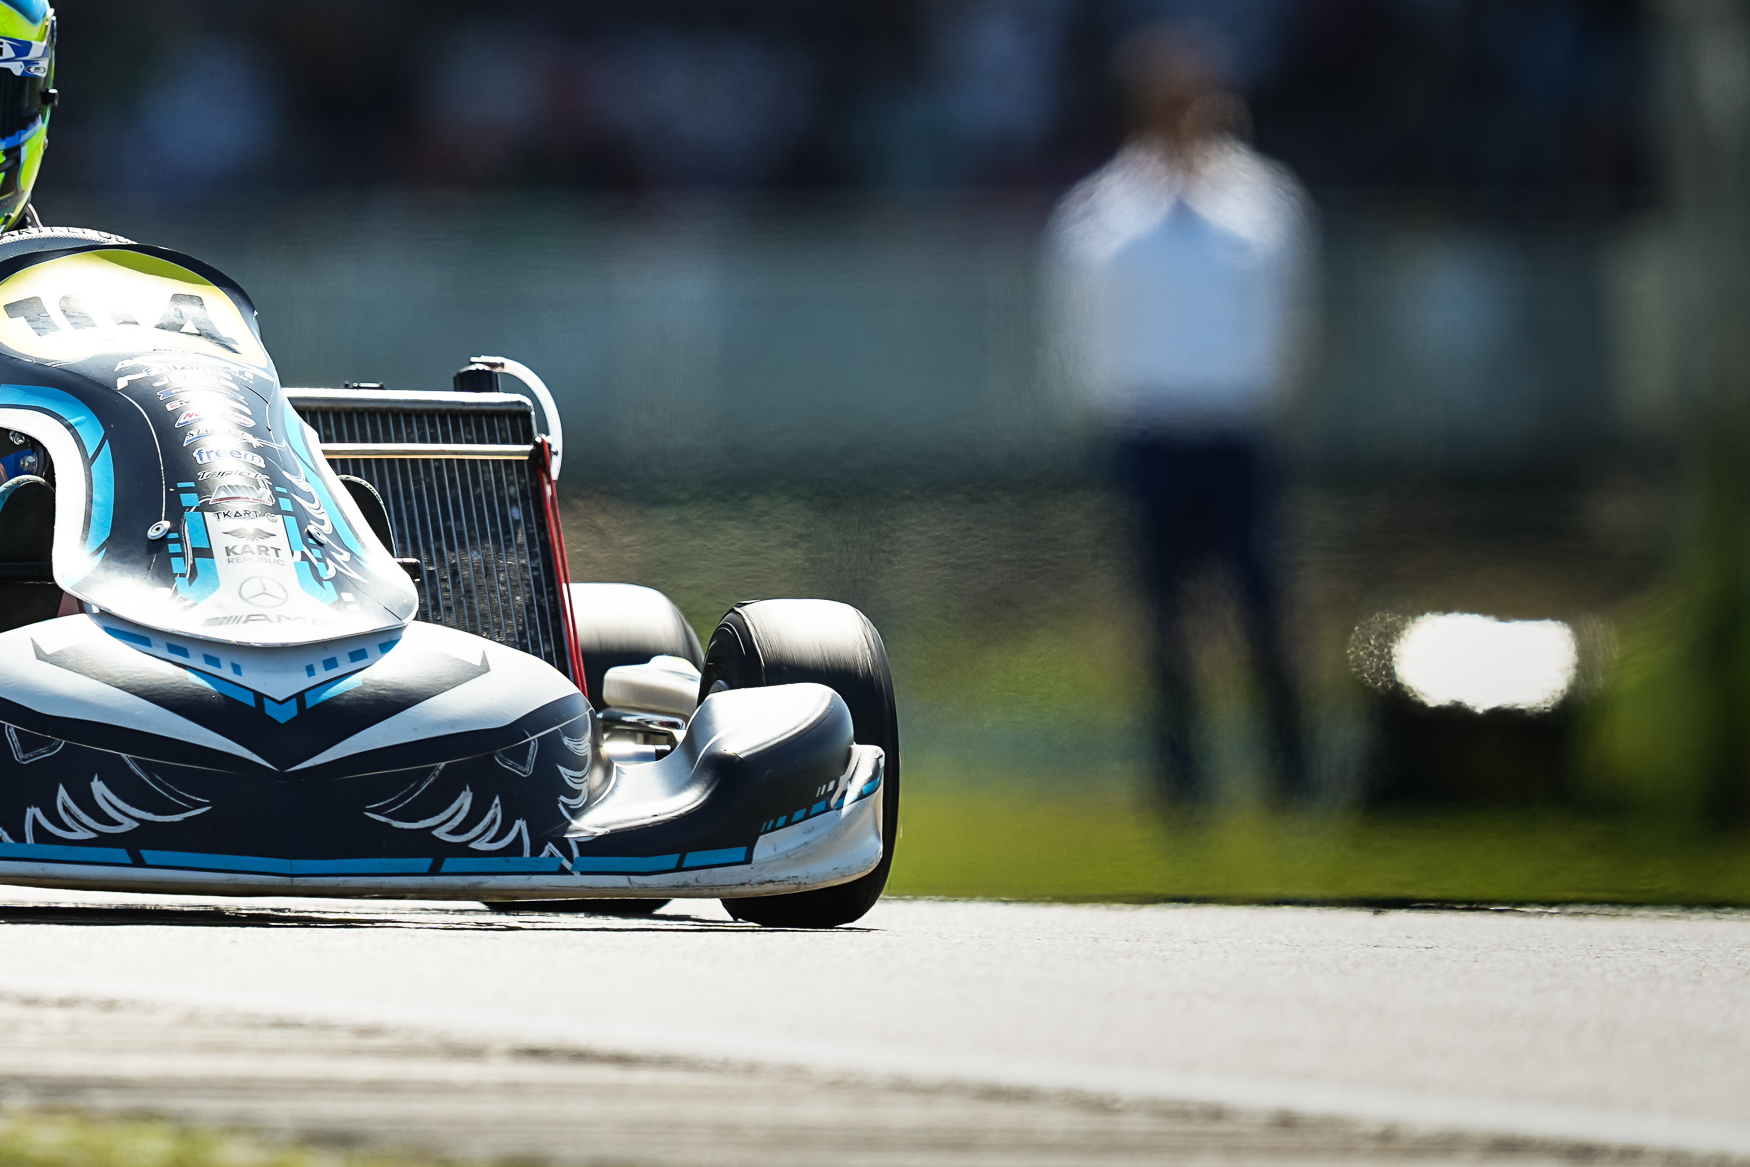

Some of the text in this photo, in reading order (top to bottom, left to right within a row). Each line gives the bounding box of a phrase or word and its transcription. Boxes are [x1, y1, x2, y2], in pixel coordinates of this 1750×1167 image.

[196, 448, 262, 464] freem
[224, 544, 282, 558] KART
[227, 556, 285, 566] REPUBLIC
